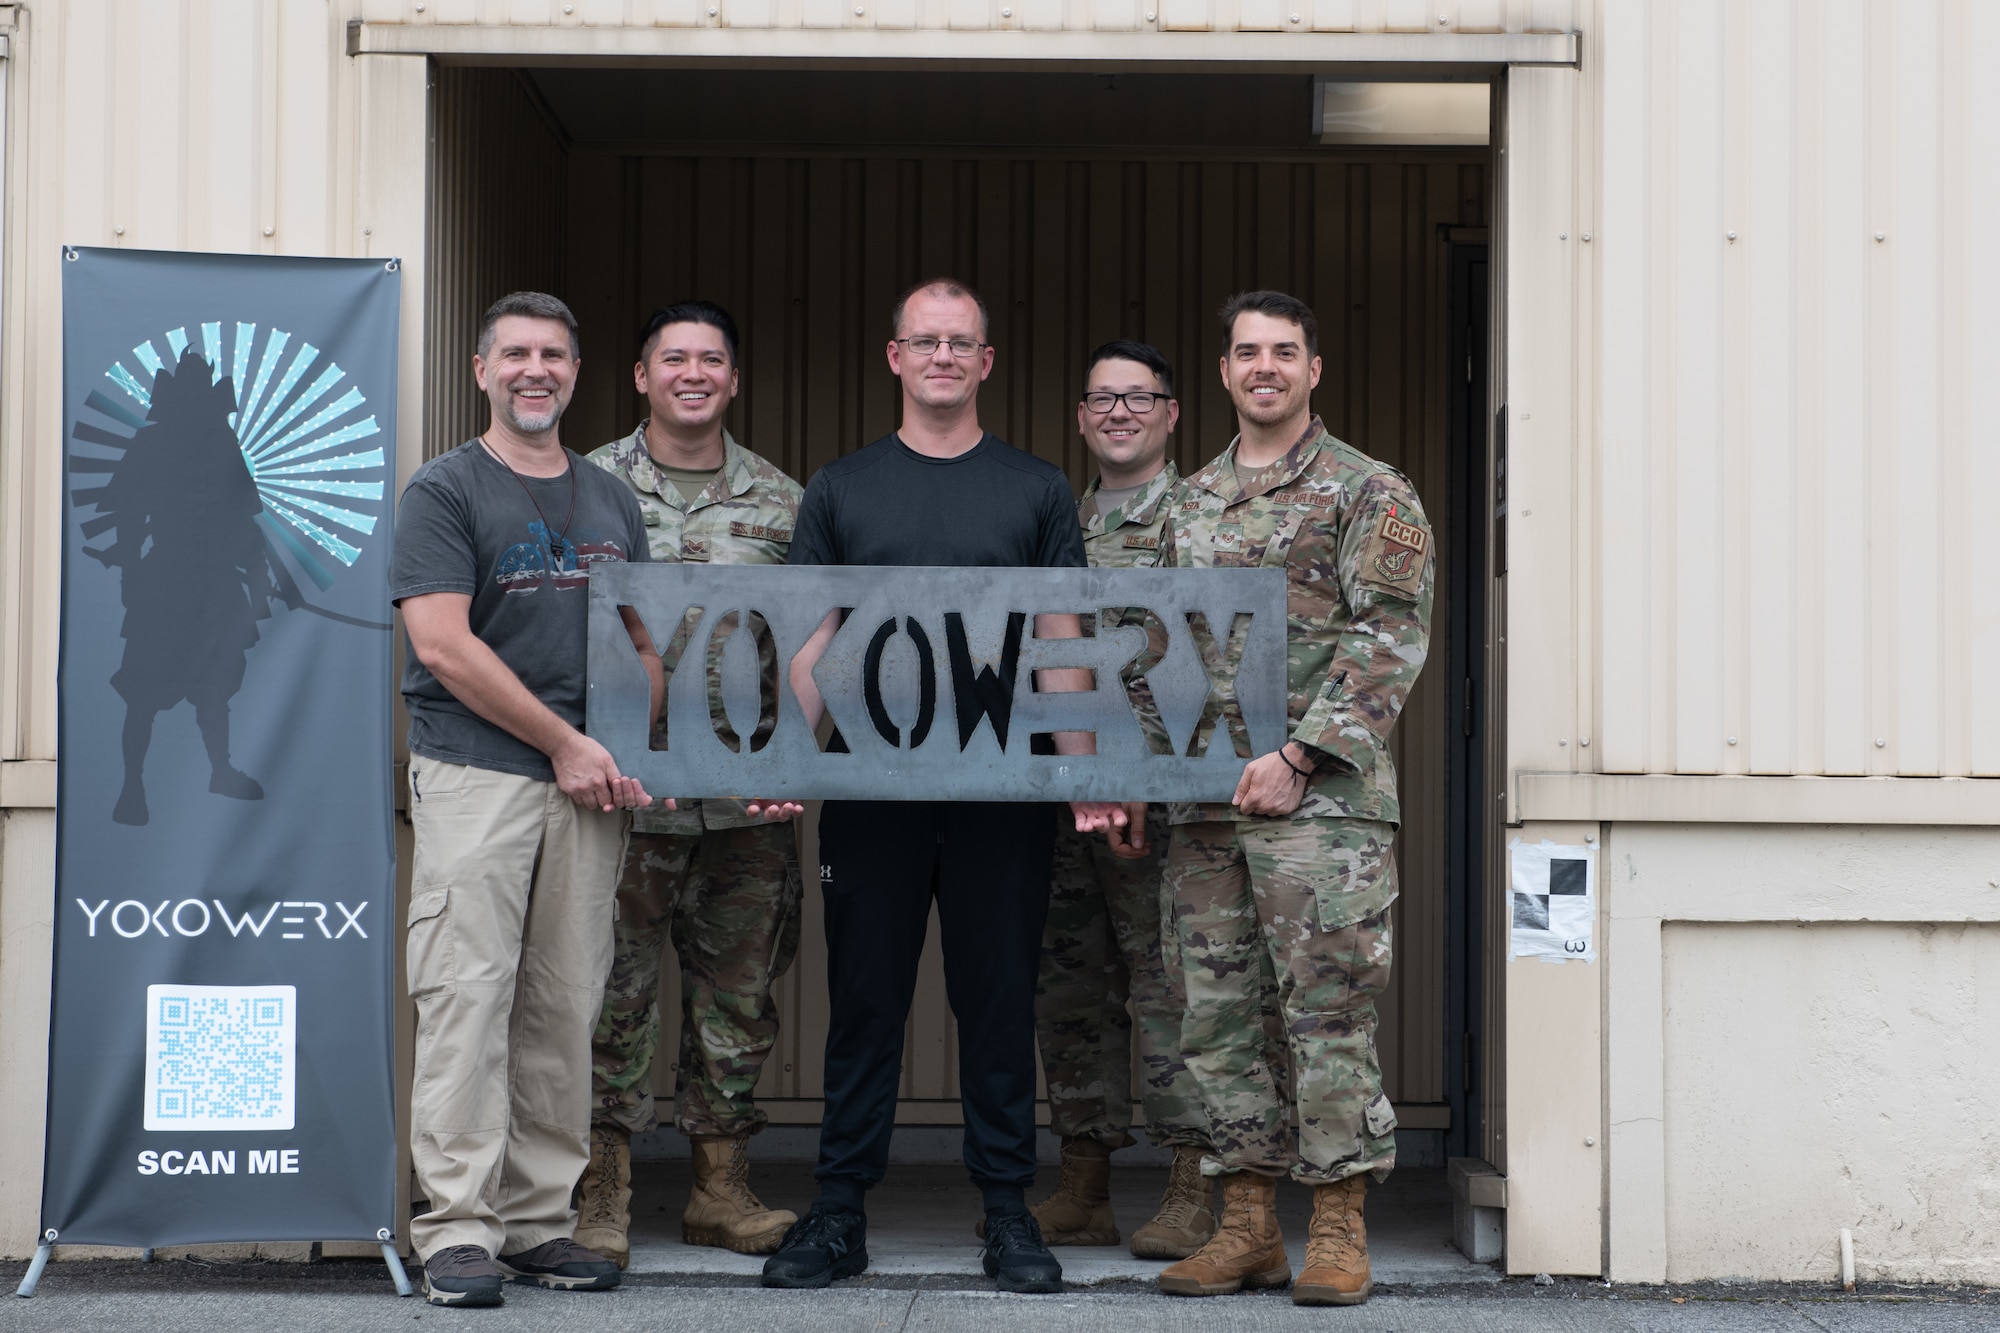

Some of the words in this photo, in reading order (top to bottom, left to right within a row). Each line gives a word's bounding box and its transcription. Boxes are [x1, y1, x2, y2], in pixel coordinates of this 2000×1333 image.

[1293, 493, 1307, 504] AIR
[751, 525, 764, 536] AIR
[766, 528, 790, 541] FORCE
[1142, 537, 1157, 548] AIR
[1387, 520, 1422, 546] CCO
[616, 604, 1256, 758] YOKOWERX
[76, 898, 369, 939] YOKOWERX
[1564, 940, 1586, 953] 3
[137, 1150, 236, 1175] SCAN
[248, 1149, 300, 1174] ME
